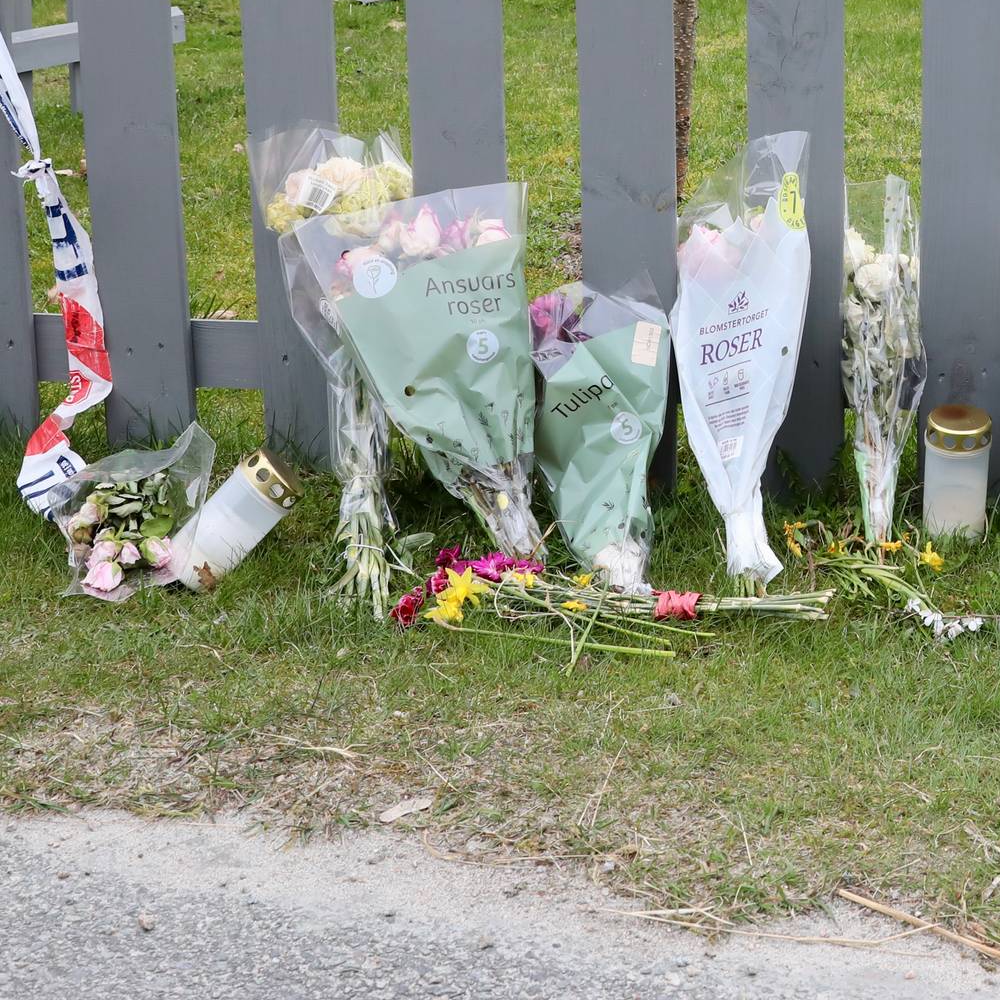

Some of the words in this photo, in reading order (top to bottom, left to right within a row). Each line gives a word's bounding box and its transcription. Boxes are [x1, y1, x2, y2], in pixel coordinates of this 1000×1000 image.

[447, 297, 502, 315] roser
[699, 308, 769, 335] BLOMSTERTORGET
[478, 337, 489, 355] 5
[700, 328, 763, 365] ROSER
[621, 418, 633, 436] 5
